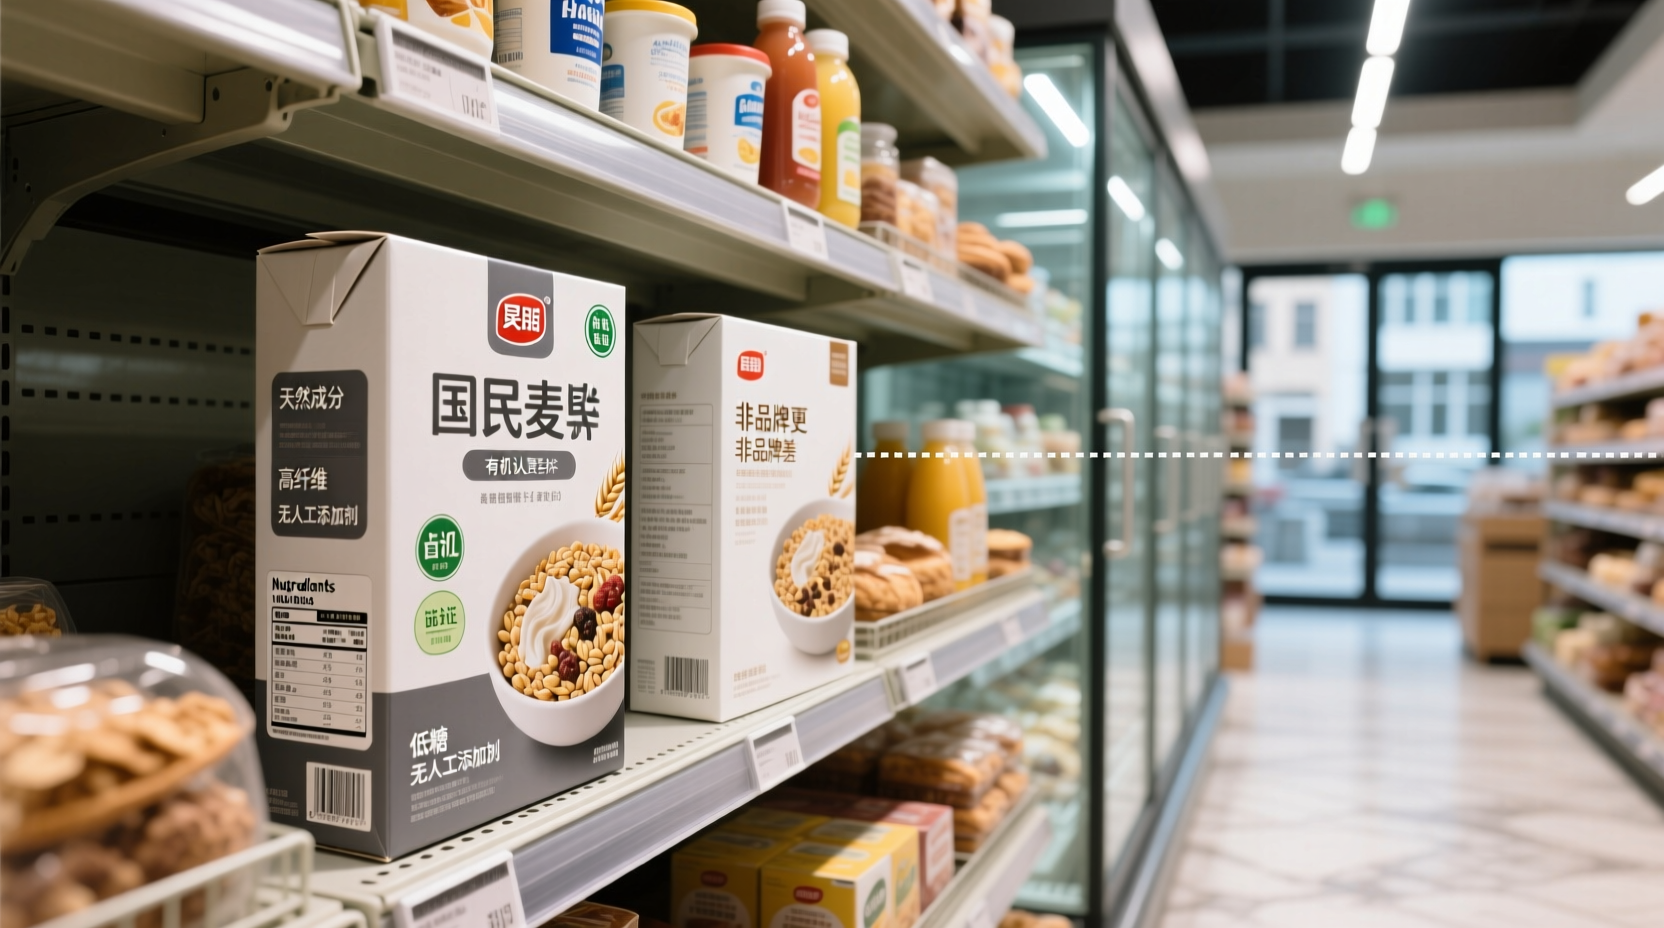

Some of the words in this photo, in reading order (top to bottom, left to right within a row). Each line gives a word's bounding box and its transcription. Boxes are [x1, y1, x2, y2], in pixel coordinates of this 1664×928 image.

[279, 385, 344, 411] 天然成分
[735, 401, 808, 434] 非品牌更
[278, 467, 328, 491] 高纤维
[409, 725, 448, 758] 低糖
